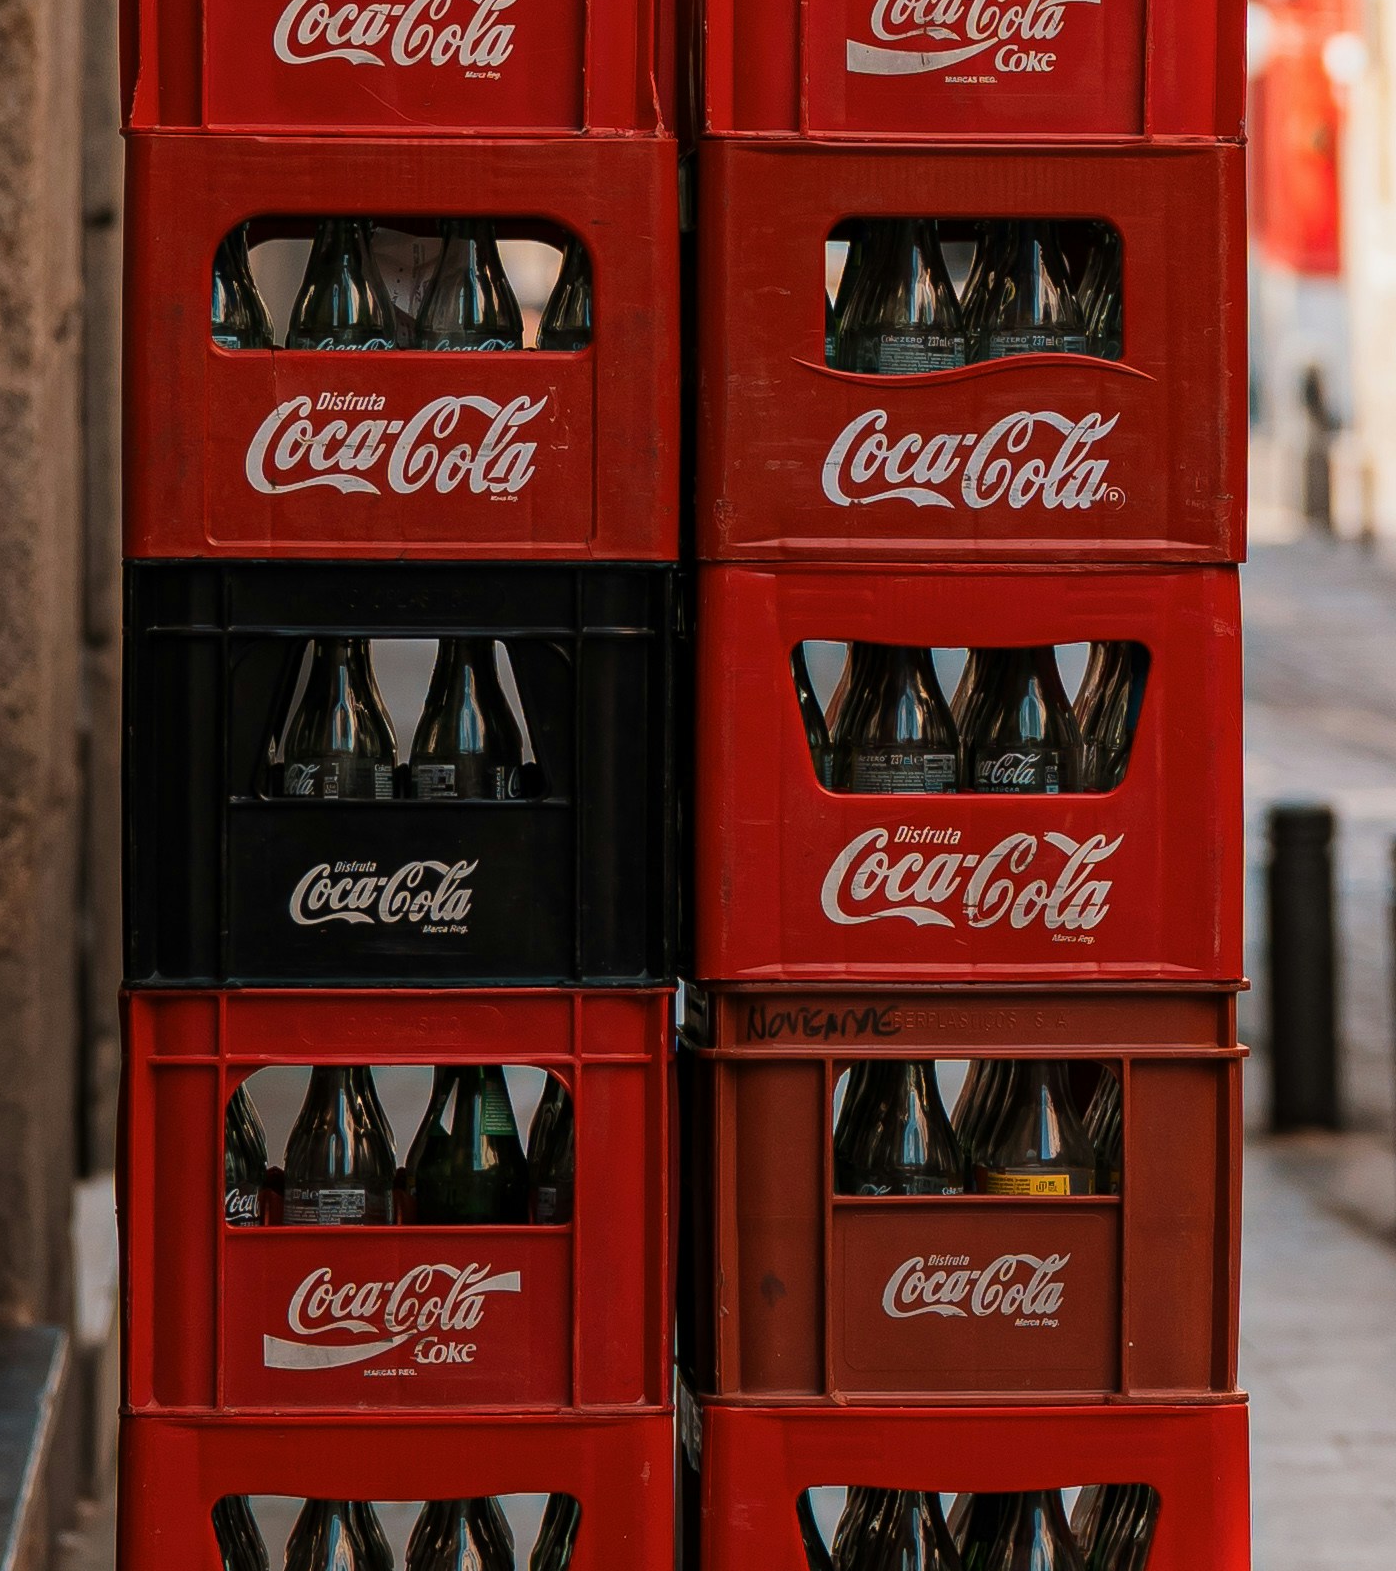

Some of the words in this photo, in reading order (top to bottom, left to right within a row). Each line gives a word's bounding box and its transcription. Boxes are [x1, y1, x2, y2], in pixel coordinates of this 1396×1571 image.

[994, 44, 1057, 73] Coke
[315, 392, 386, 412] Disfruta
[245, 395, 548, 495] Coca-Cola
[821, 409, 1120, 509] Coca-Cola
[894, 825, 961, 844] Disfruta
[334, 860, 377, 874] Disfruta
[820, 828, 1124, 930] Coca-Cola
[289, 858, 479, 925] Coca-Cola
[423, 925, 448, 933] Marca
[449, 925, 469, 935] Reg.
[1052, 934, 1076, 942] Marca
[1077, 934, 1095, 945] Reg.
[890, 1011, 1016, 1028] BERPLASTICOS
[927, 1254, 970, 1267] Disfruta
[882, 1252, 1071, 1318] Coca-Cola
[287, 1262, 492, 1335] Coca-Cola
[1015, 1318, 1039, 1326] Marca
[1041, 1318, 1060, 1328] Reg.
[414, 1335, 477, 1363] Coke
